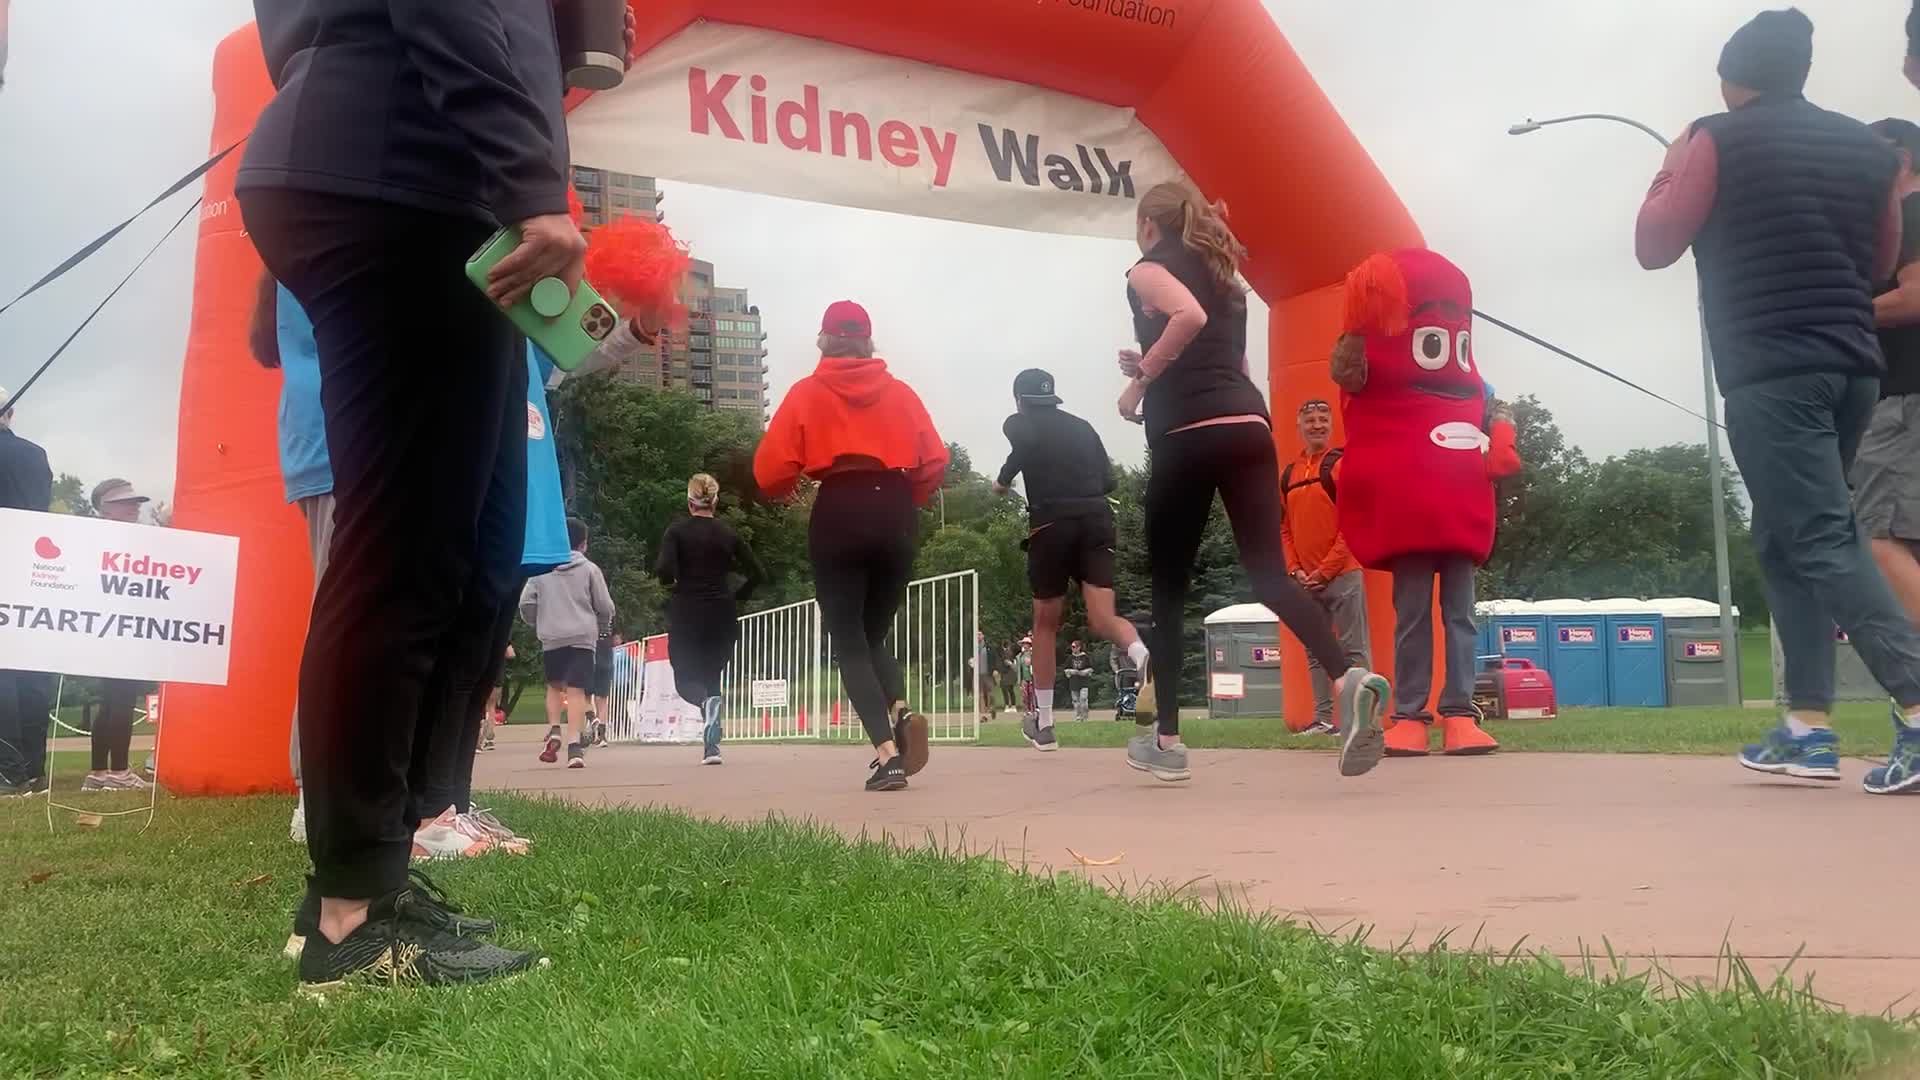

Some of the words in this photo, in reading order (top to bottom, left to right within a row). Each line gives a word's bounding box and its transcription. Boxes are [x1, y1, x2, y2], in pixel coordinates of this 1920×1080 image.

[1055, 0, 1175, 28] undation
[688, 67, 957, 187] Kidney
[977, 122, 1136, 198] Walk
[101, 551, 202, 585] Kidney
[100, 574, 170, 600] Walk
